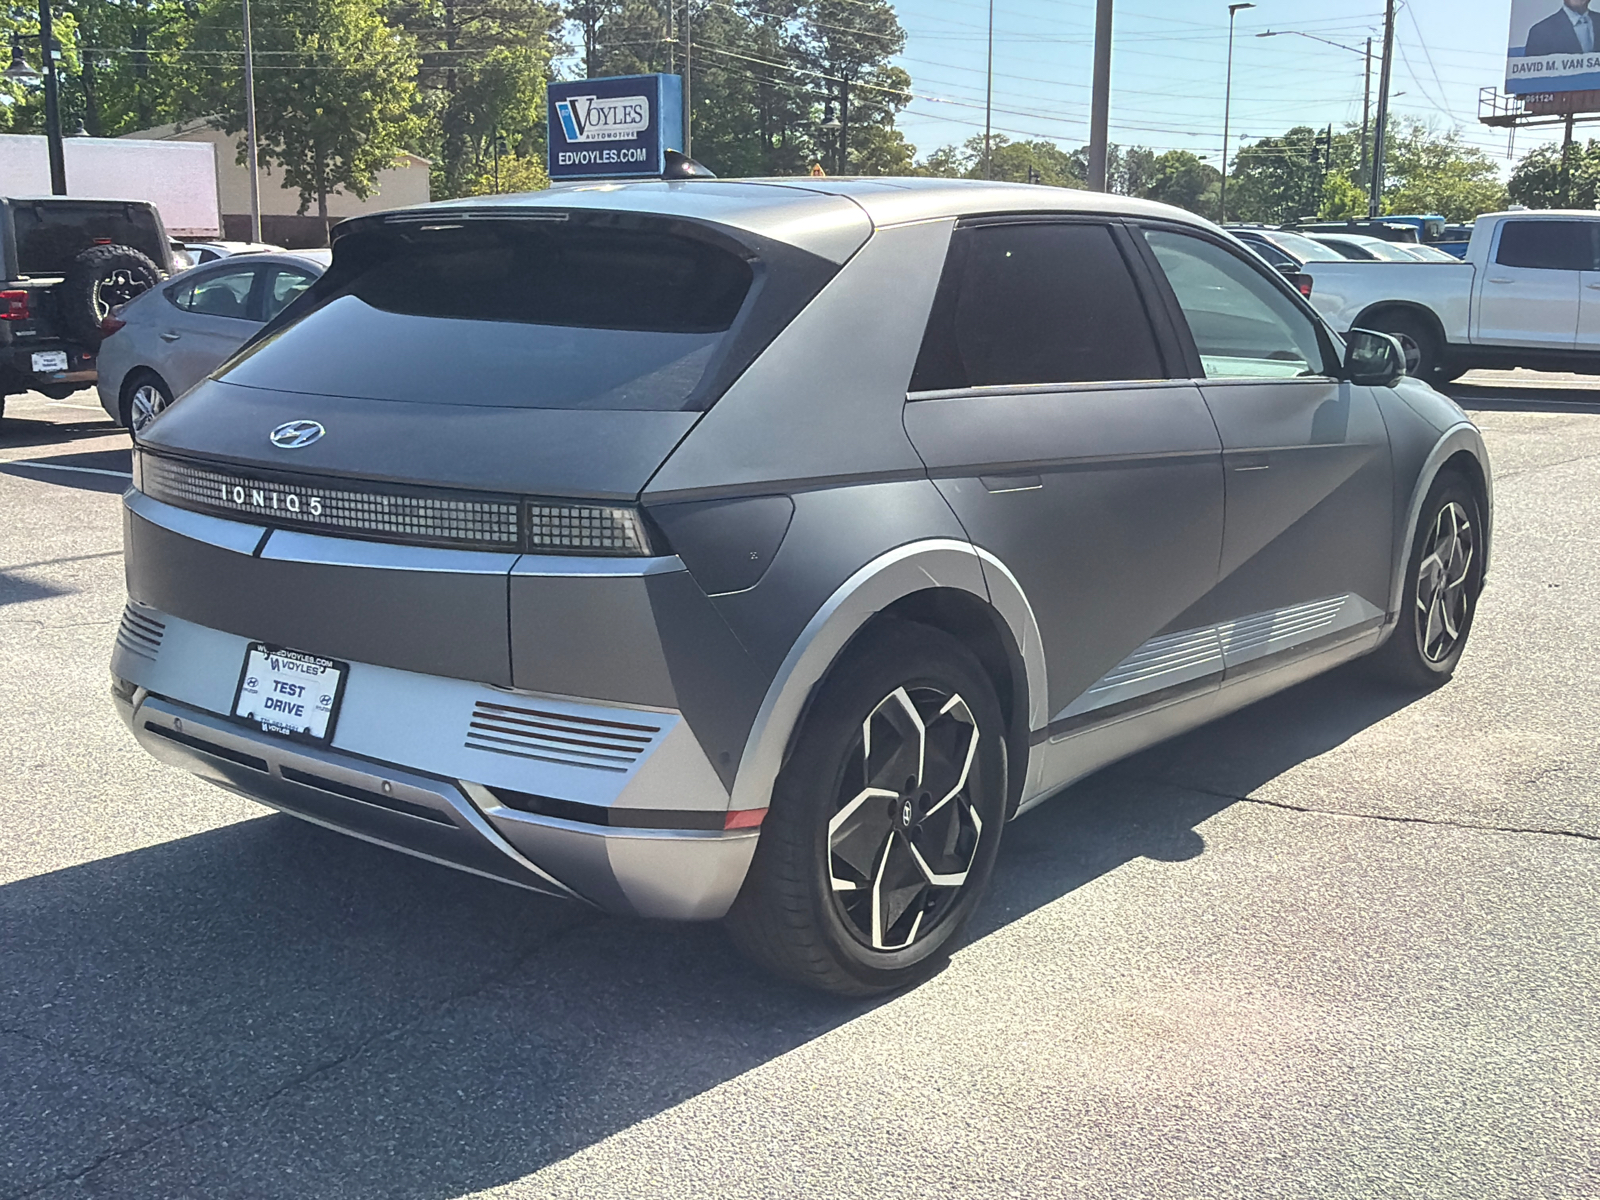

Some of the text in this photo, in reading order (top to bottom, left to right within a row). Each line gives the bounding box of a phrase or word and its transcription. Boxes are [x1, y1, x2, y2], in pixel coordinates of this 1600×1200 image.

[1512, 62, 1543, 74] DAVID
[1546, 61, 1558, 71] M.
[1562, 58, 1583, 70] VAN
[569, 98, 643, 136] VOYLES
[586, 131, 635, 140] AUTOMOTIVE
[559, 148, 647, 165] EDVOYLES.COM
[222, 484, 322, 515] IONIQ 5
[282, 659, 319, 676] VOYLES
[273, 680, 306, 698] TEST
[264, 697, 304, 717] DRIVE
